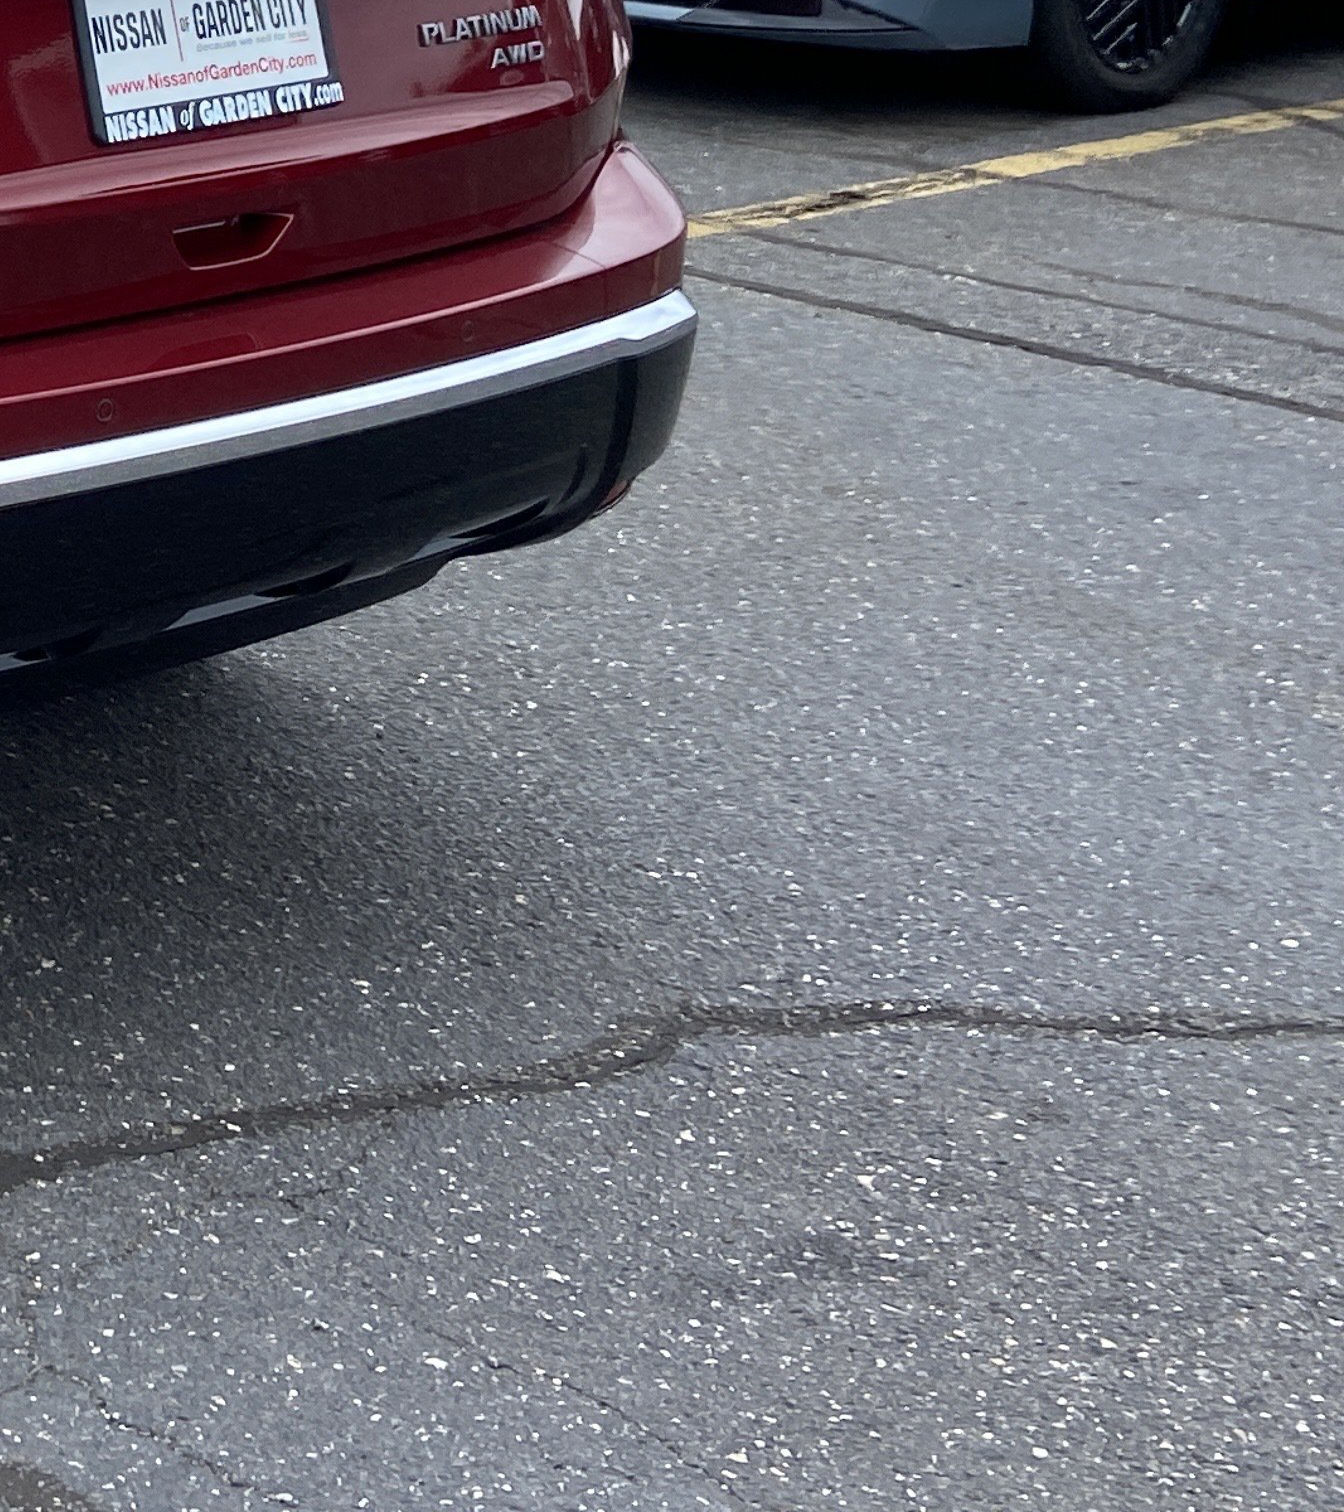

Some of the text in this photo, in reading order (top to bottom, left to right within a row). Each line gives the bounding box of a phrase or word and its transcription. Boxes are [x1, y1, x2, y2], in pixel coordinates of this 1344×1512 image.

[90, 7, 168, 55] NISSAN
[179, 16, 190, 32] OF
[417, 4, 543, 47] PLATINUM
[106, 52, 318, 97] www.NissanofGardenCity.com
[490, 40, 545, 69] AWD
[104, 81, 345, 144] NISSAN of GARDEN CITY.com
